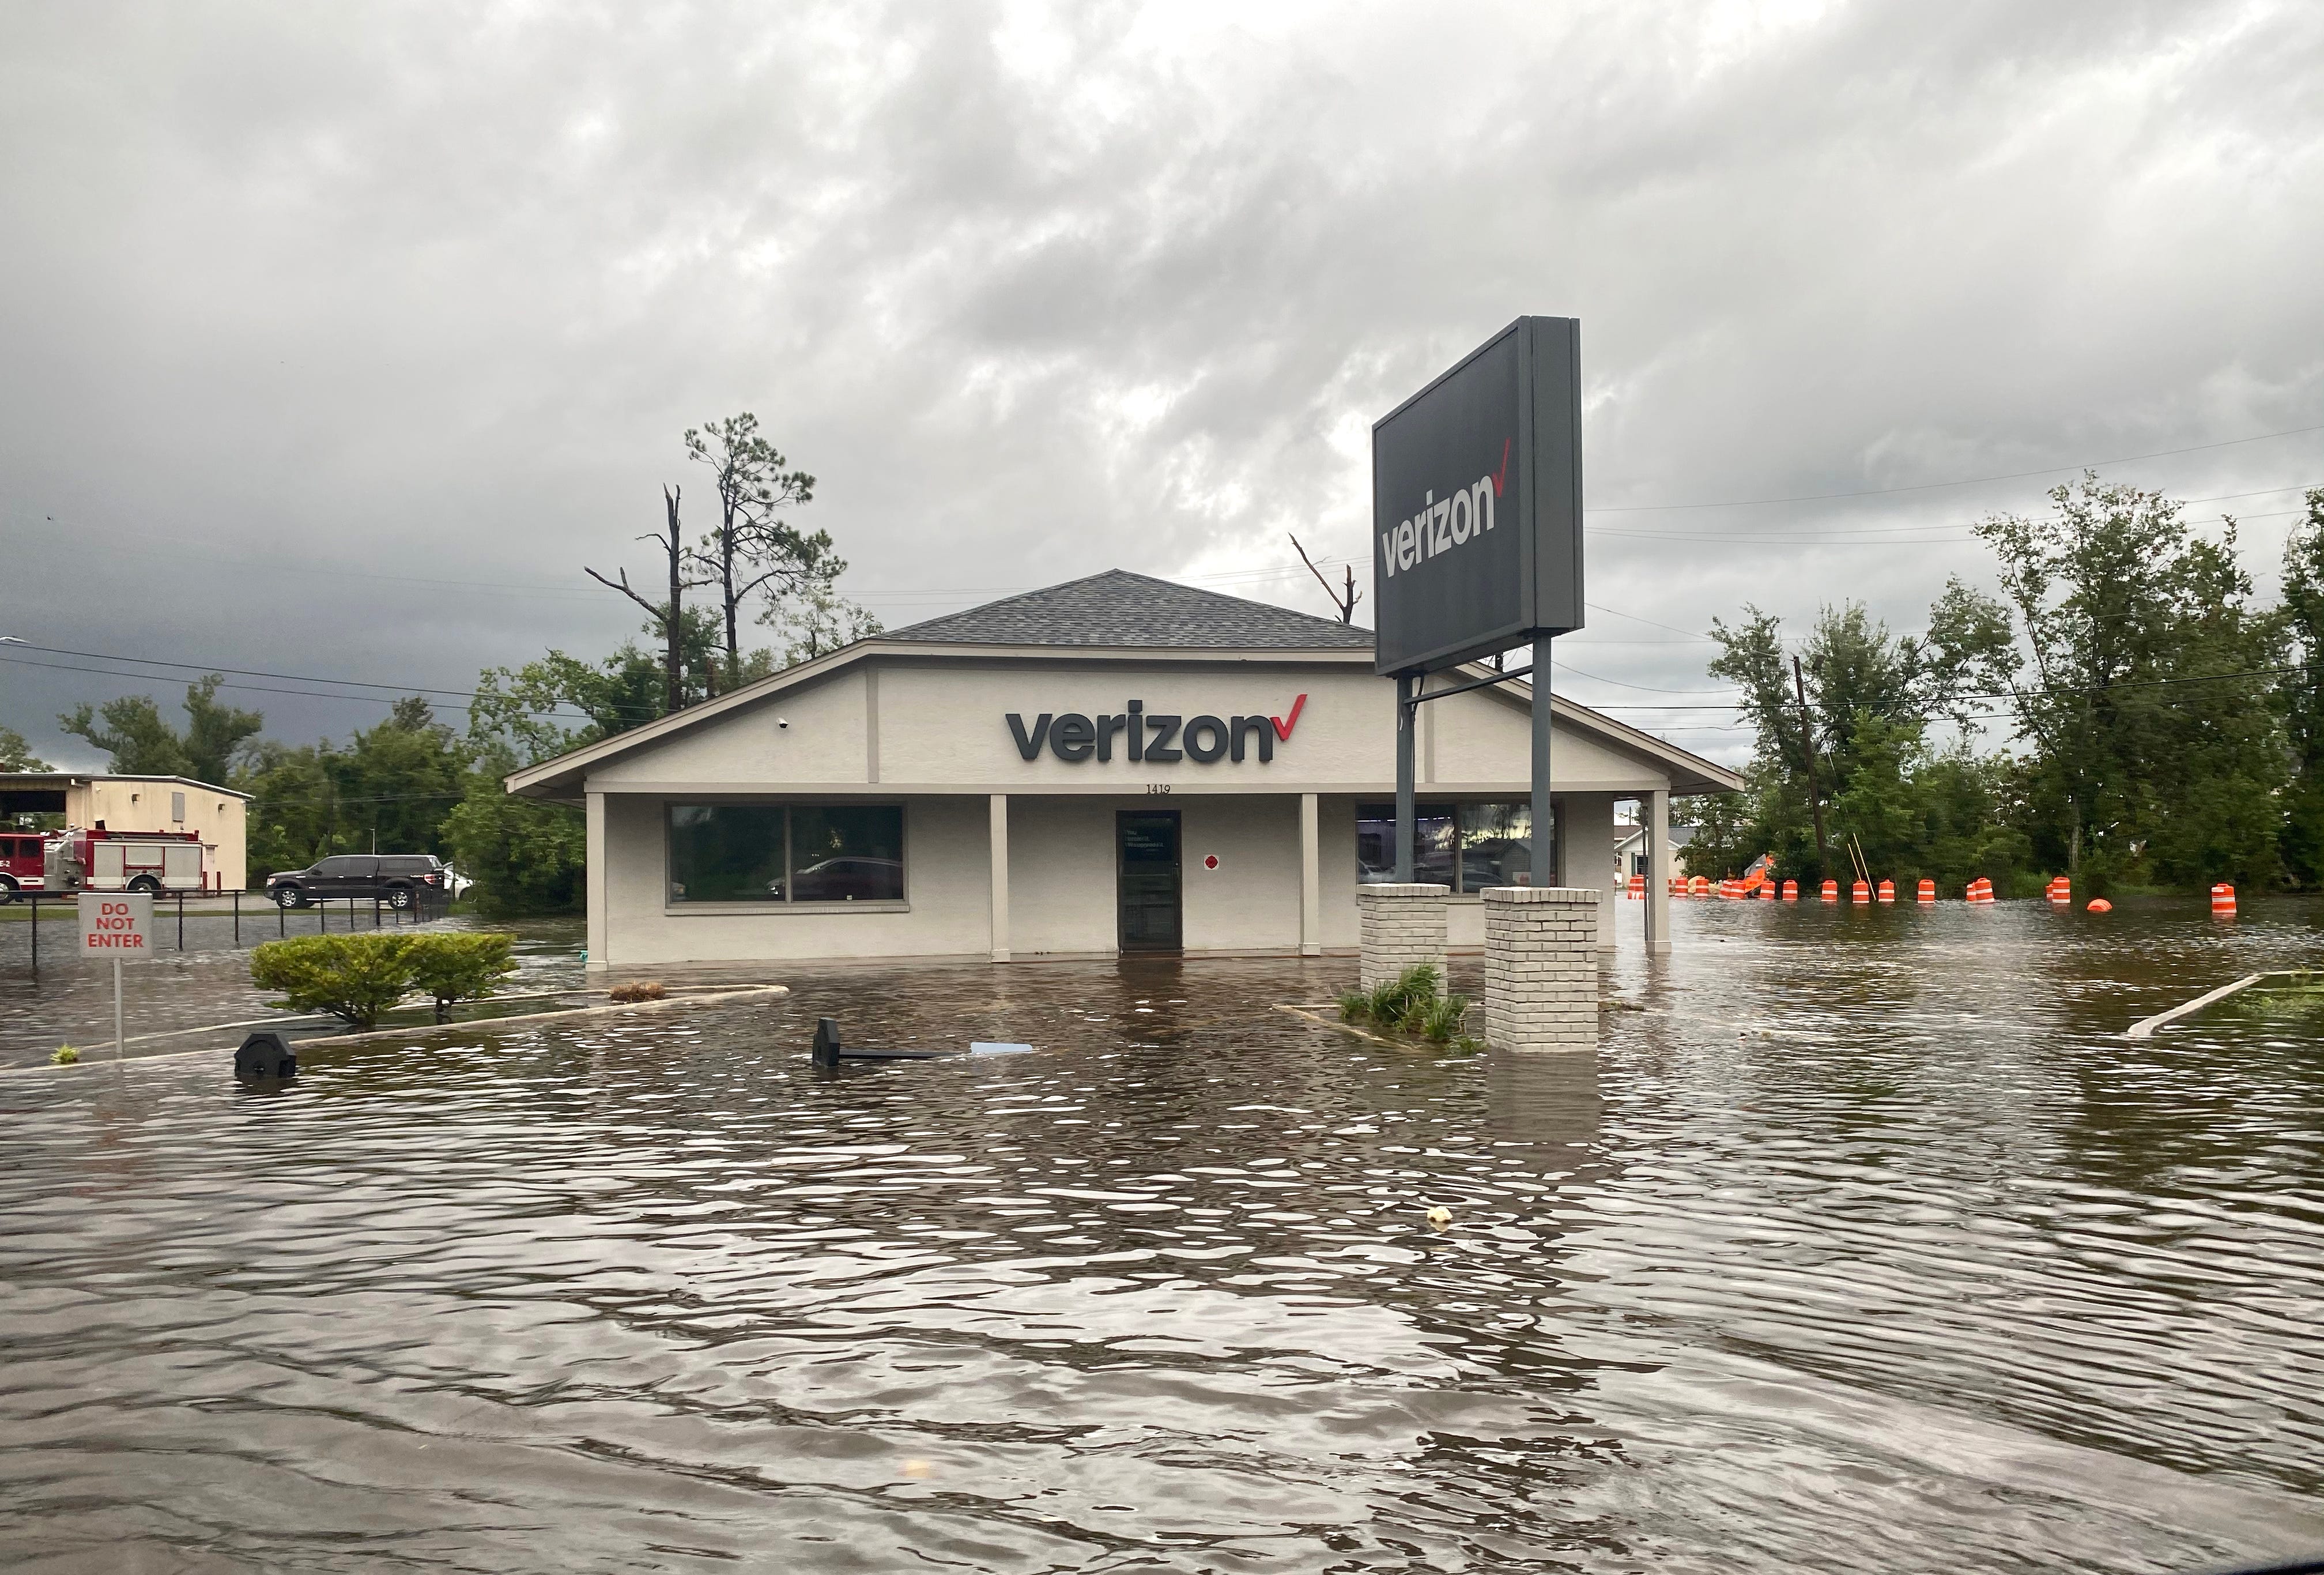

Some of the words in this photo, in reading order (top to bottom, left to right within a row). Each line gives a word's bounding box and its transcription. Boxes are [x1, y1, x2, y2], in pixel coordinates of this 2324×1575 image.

[1382, 475, 1495, 578] verizon
[1005, 699, 1273, 762] verizon
[1146, 784, 1171, 794] 1419
[101, 903, 129, 915] DO
[96, 918, 135, 930] NOT
[88, 934, 144, 948] ENTER
